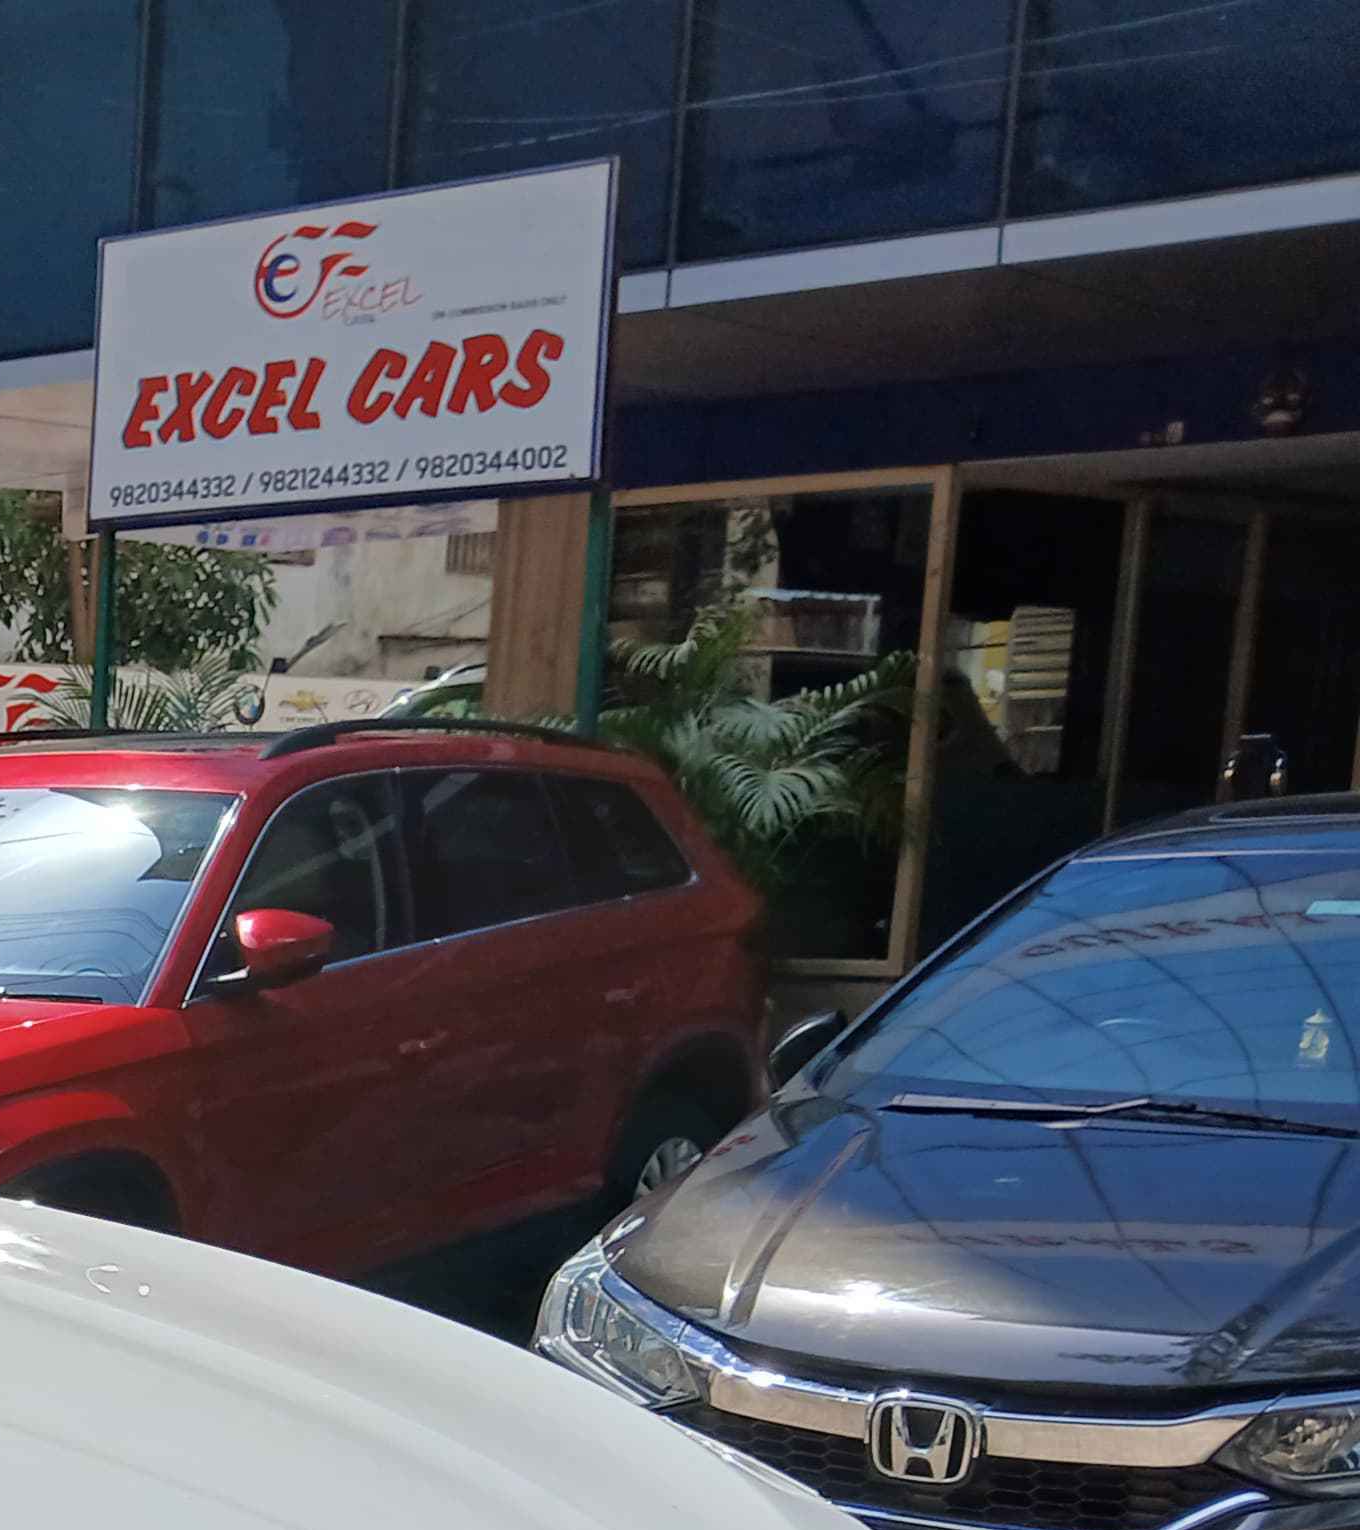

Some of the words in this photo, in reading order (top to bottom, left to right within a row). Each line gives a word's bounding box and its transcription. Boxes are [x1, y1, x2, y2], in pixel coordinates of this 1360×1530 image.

[122, 357, 328, 449] EXCEL
[346, 329, 565, 425] CARS
[110, 474, 236, 508] 9820344332
[259, 461, 390, 494] 9821244332
[414, 444, 569, 480] 9820344002
